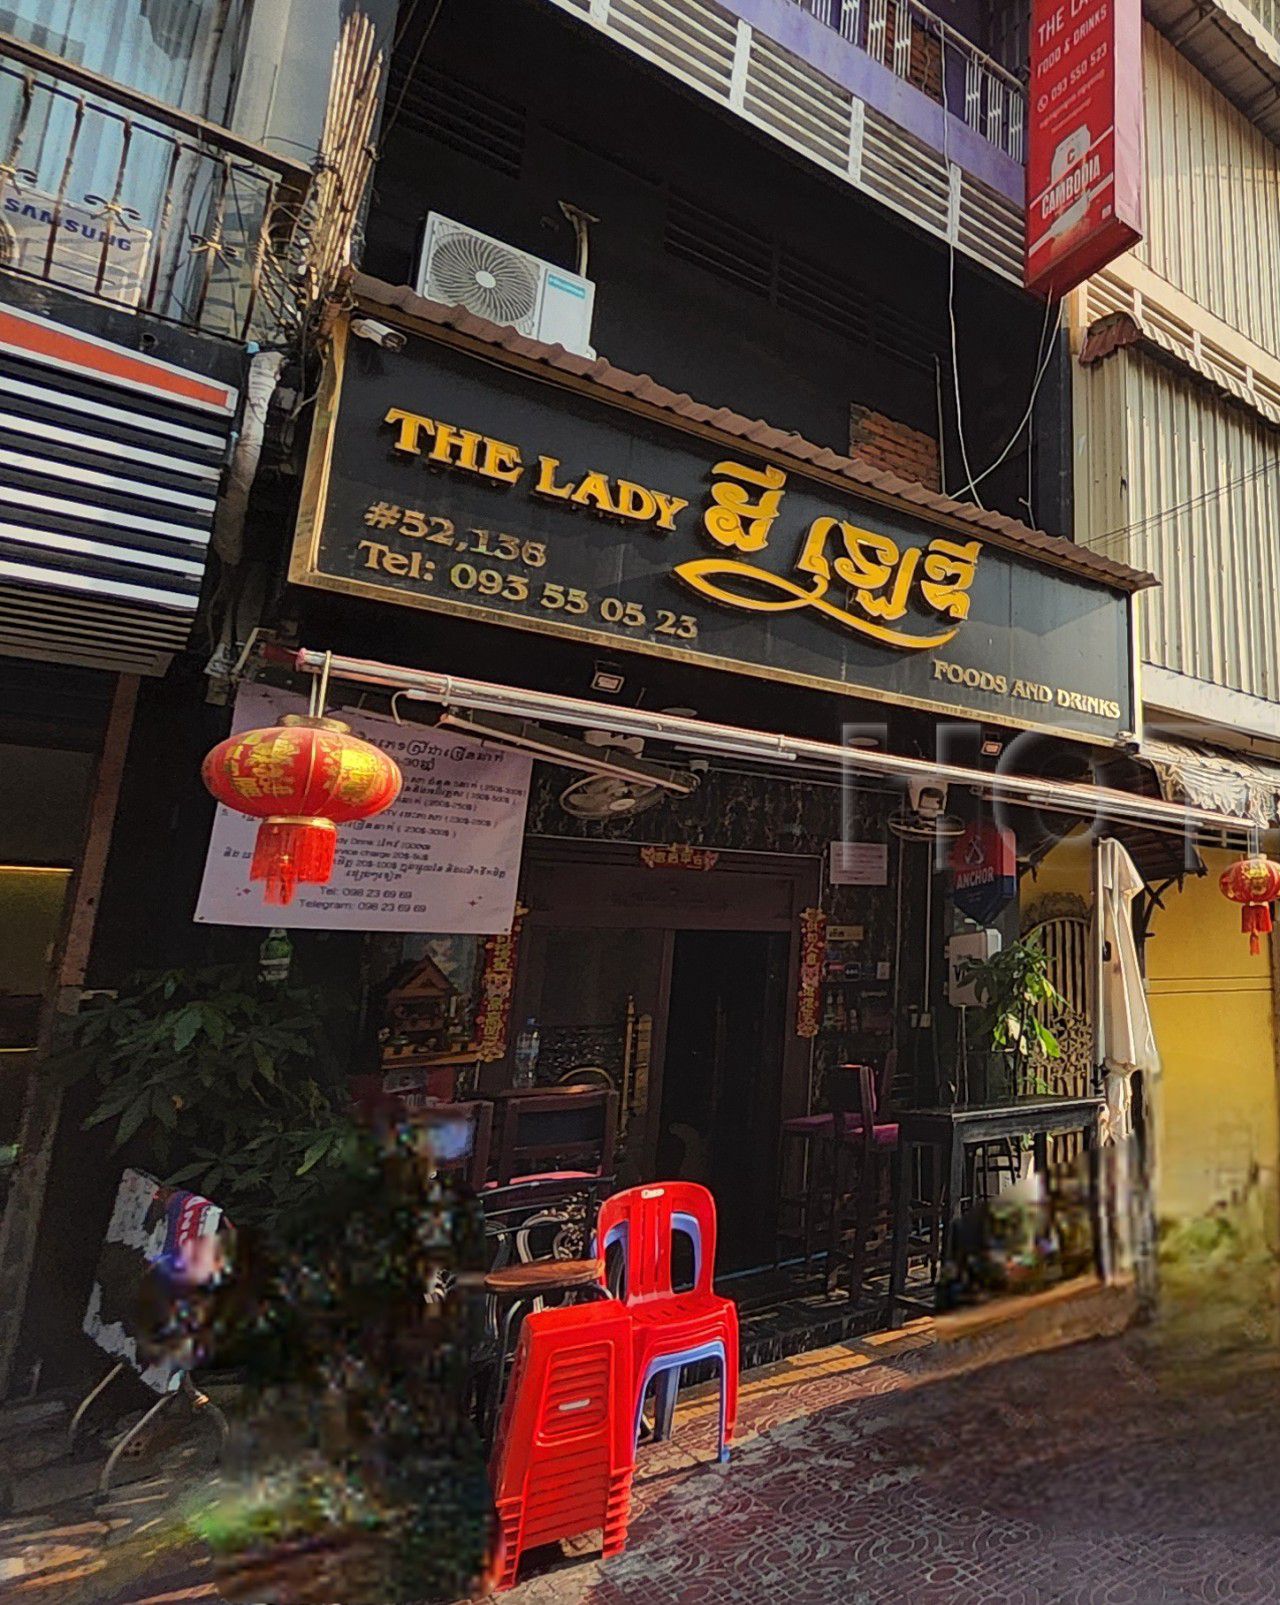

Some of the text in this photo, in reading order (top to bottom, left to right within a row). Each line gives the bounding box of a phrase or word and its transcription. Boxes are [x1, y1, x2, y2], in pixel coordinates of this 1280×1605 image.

[1073, 4, 1108, 46] DRINKS
[1041, 154, 1100, 220] CAMBODIA
[383, 407, 689, 532] THE LADY
[358, 539, 700, 640] Tel: 093 55 05 23
[932, 658, 1121, 720] FOODS AND DRINKS
[956, 865, 995, 890] ANCHOR
